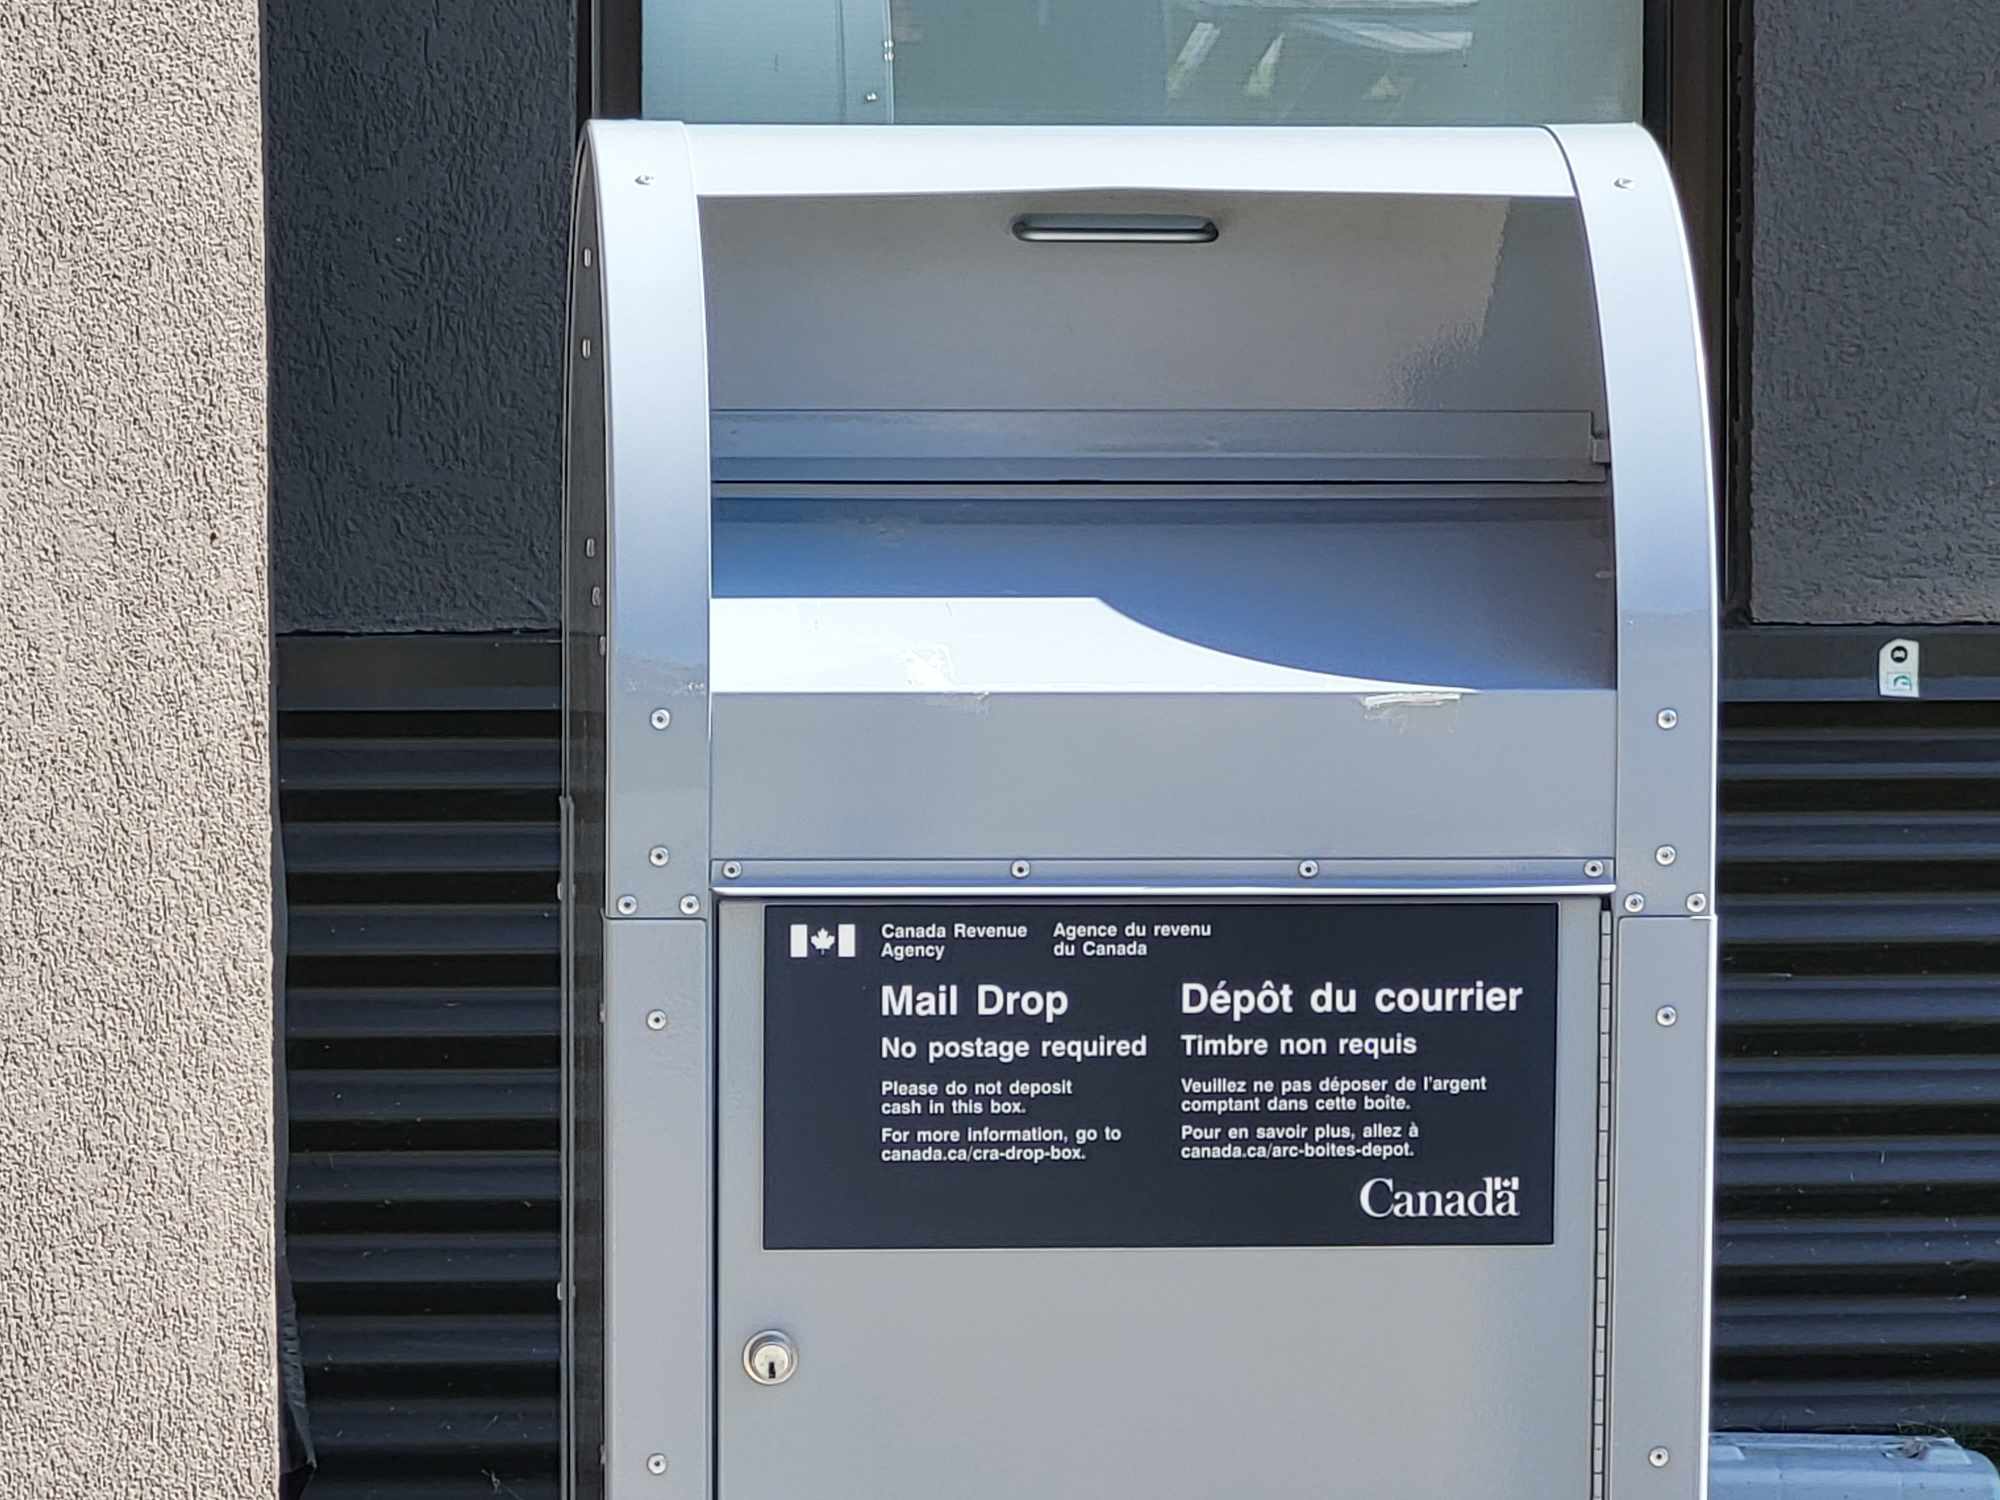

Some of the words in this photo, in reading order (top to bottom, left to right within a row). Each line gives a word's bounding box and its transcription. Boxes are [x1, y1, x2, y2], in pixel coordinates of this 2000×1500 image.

[882, 924, 946, 938] Canada
[954, 924, 1027, 937] Revenue
[1053, 923, 1117, 940] Agence
[1125, 923, 1146, 936] du
[1154, 925, 1211, 936] revenu
[881, 943, 944, 960] Agency
[1054, 941, 1075, 956] du
[1083, 941, 1147, 955] Canada
[882, 985, 957, 1016] Mail
[978, 984, 1068, 1023] Drop
[1182, 980, 1293, 1021] Dépôt
[1311, 982, 1356, 1013] du
[1375, 981, 1523, 1012] courrier
[882, 1037, 916, 1058] No
[929, 1037, 1029, 1063] postage
[1042, 1035, 1146, 1062] required
[1181, 1034, 1268, 1055] Timbre
[1280, 1038, 1326, 1054] non
[1339, 1033, 1417, 1059] requis
[882, 1081, 938, 1095] Please
[946, 1081, 967, 1095] do
[975, 1081, 1002, 1095] not
[1009, 1080, 1072, 1098] deposit
[1181, 1078, 1246, 1092] Veuillez
[1254, 1081, 1274, 1092] ne
[1282, 1080, 1312, 1095] pas
[1319, 1076, 1387, 1095] déposer
[1395, 1076, 1416, 1091] de
[1424, 1076, 1486, 1094] l'argent
[882, 1100, 921, 1114] cash
[929, 1100, 944, 1113] in
[952, 1100, 983, 1113] this
[991, 1099, 1025, 1113] box.
[1181, 1097, 1260, 1114] comptant
[1267, 1096, 1308, 1111] dans
[1316, 1095, 1356, 1110] cette
[882, 1128, 910, 1142] For
[917, 1130, 960, 1142] more
[968, 1127, 1067, 1143] information,
[1076, 1129, 1097, 1144] go
[1105, 1126, 1121, 1140] to
[1182, 1125, 1221, 1139] Pour
[1228, 1128, 1248, 1139] en
[1256, 1124, 1308, 1139] savoir
[1315, 1124, 1355, 1142] plus,
[1363, 1123, 1402, 1137] allez
[1409, 1122, 1418, 1137] à
[882, 1147, 1085, 1163] canada.ca/cra-drop-box.
[1181, 1143, 1413, 1160] canada.ca/arc-boites-depot.
[1360, 1177, 1519, 1217] Canada
